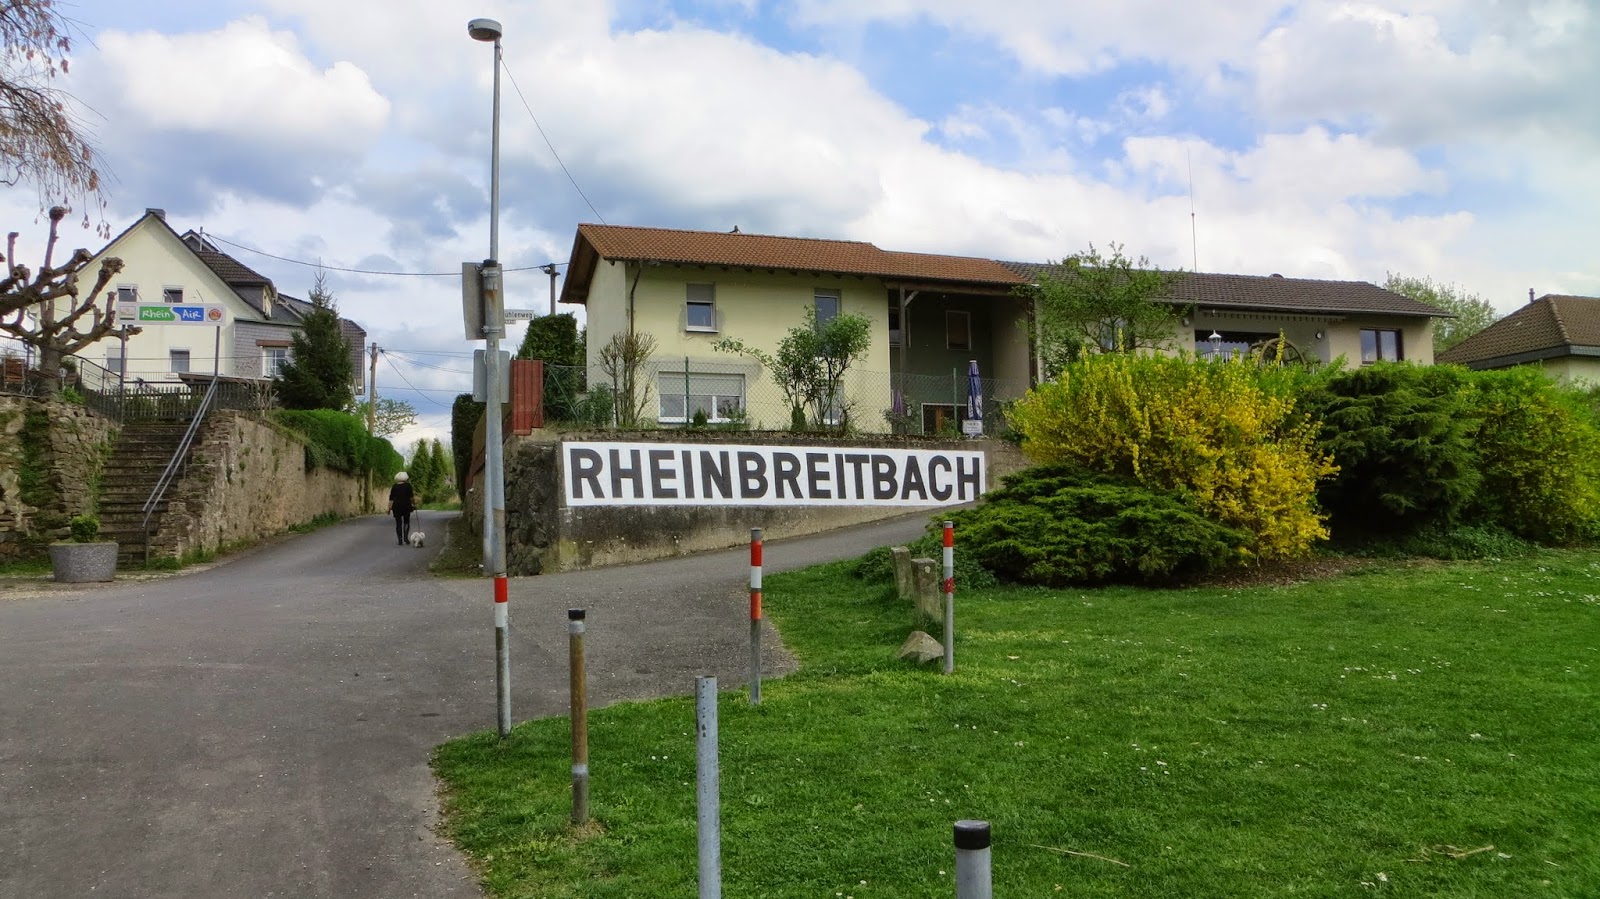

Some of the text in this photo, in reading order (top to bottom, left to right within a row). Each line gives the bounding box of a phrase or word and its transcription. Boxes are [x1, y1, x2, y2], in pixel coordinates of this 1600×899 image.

[142, 309, 171, 318] Rhein
[505, 311, 532, 319] ühlenweg
[570, 448, 980, 501] RHEINBREITBACH
